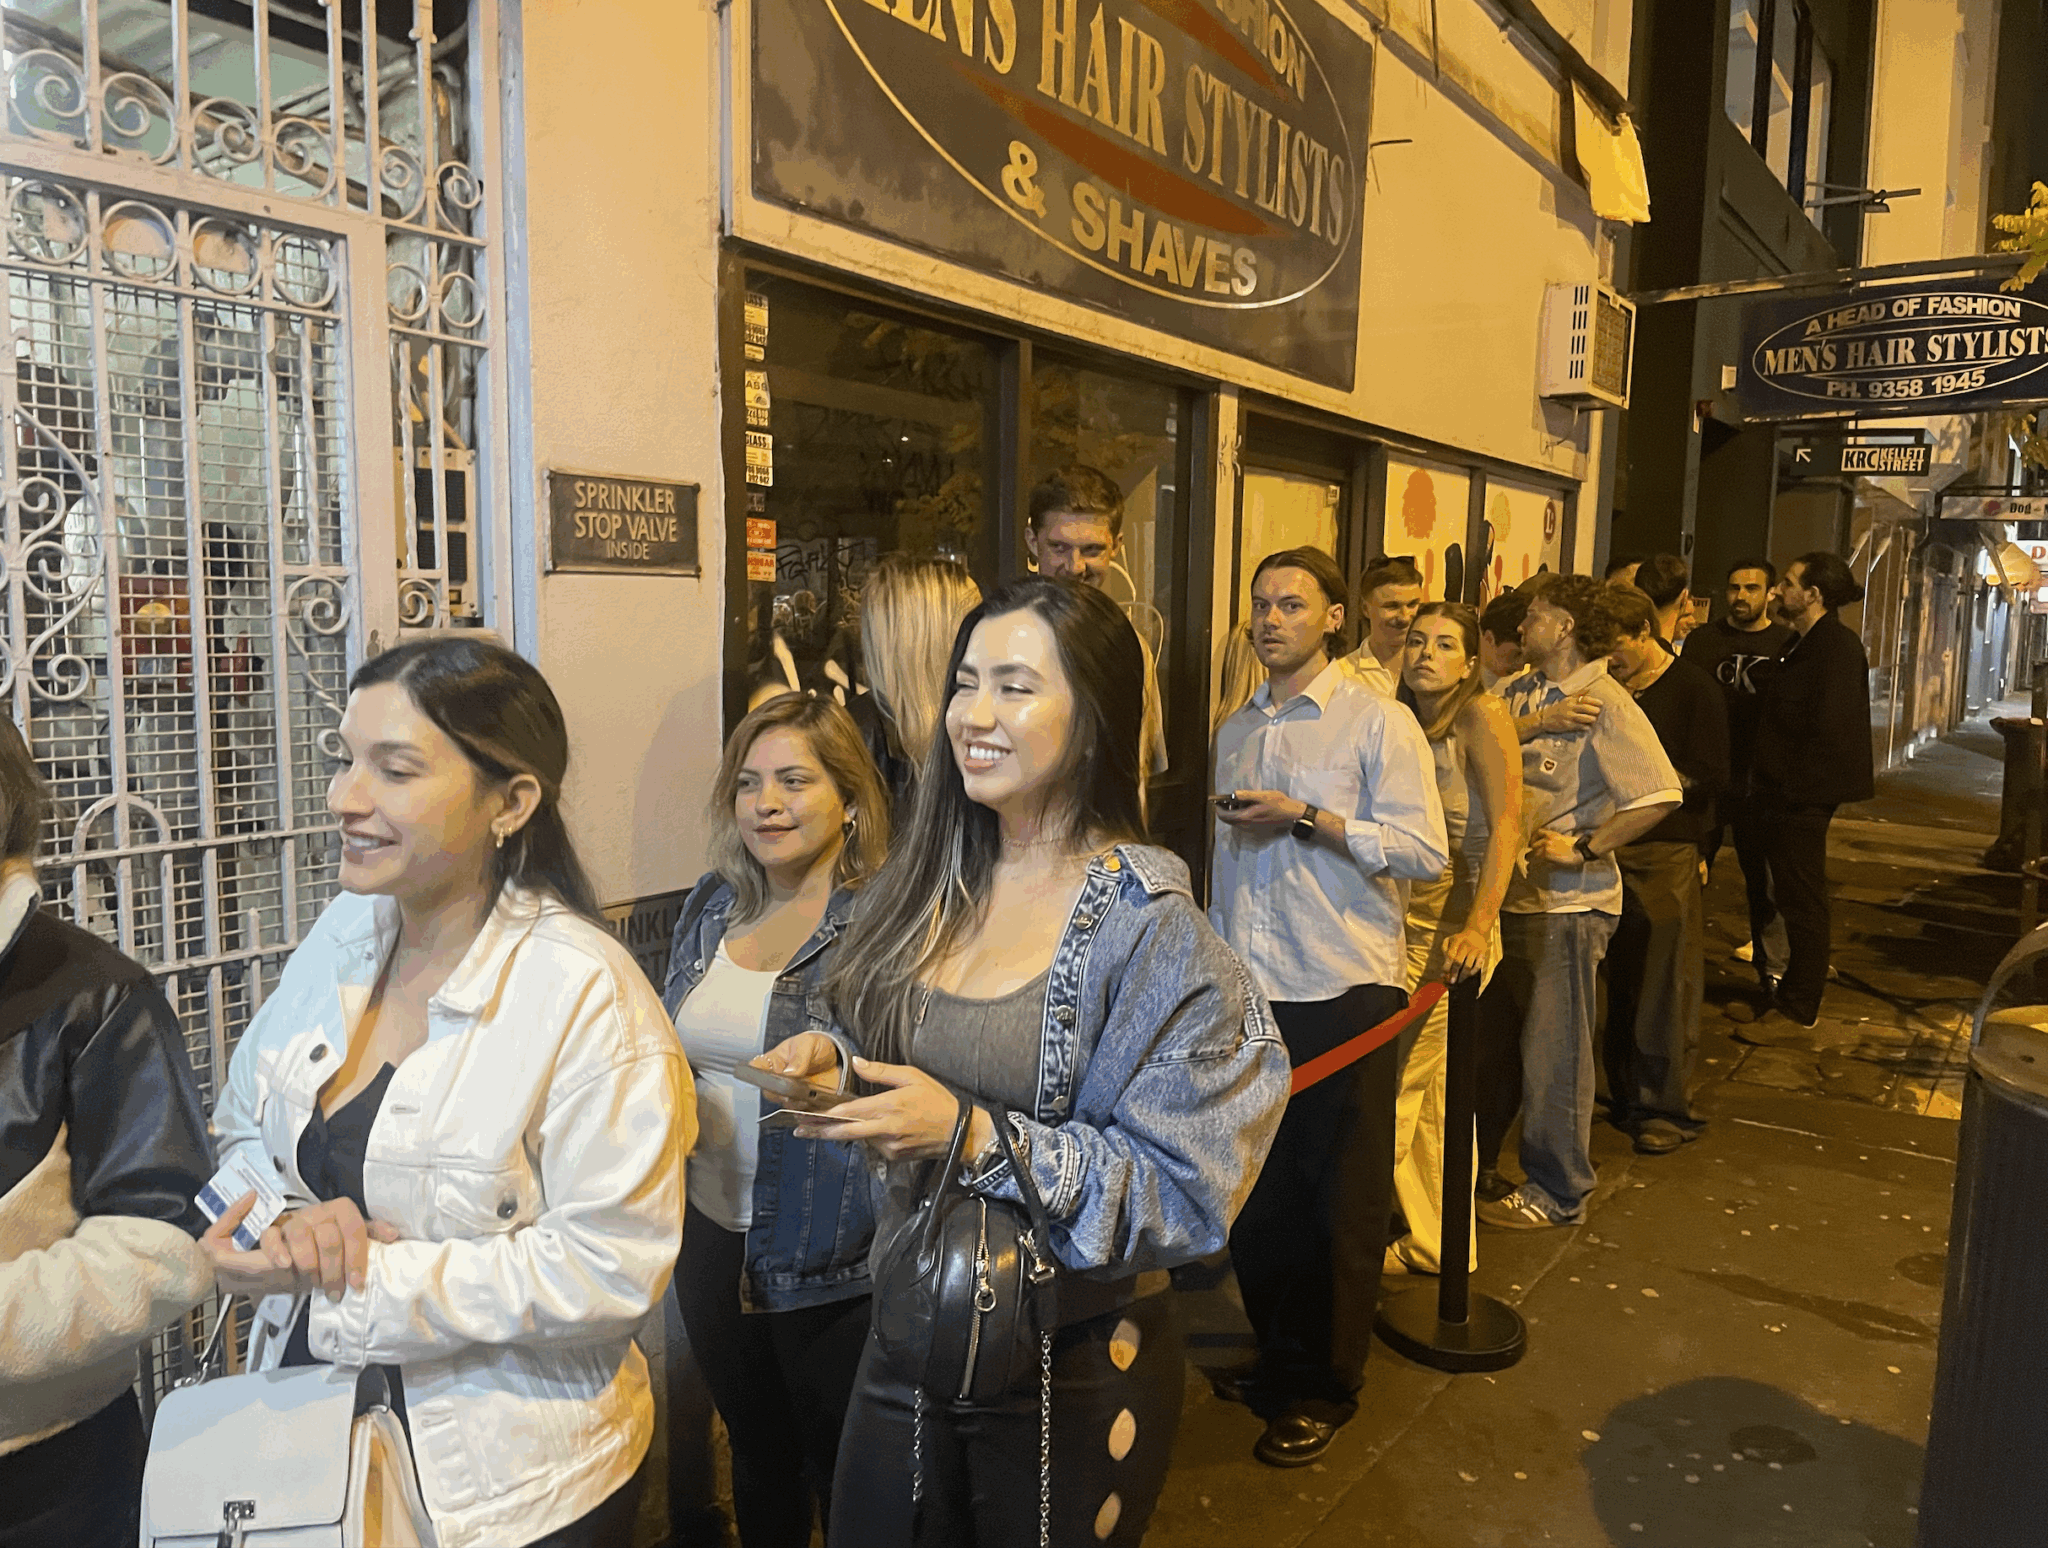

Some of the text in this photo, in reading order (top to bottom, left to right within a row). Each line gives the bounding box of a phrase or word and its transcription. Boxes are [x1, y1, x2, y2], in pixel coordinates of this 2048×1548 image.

[1037, 0, 1168, 157] HAIR
[1183, 64, 1346, 247] STYLISTS
[1001, 140, 1258, 297] & SHAVES
[1805, 296, 2022, 336] A HEAD OF FASHION
[1763, 340, 1838, 377] MEN'S
[1846, 336, 1917, 370] HAIR
[1868, 380, 1924, 399] 9358
[1931, 369, 1986, 395] 1945
[1844, 450, 1878, 469] KRC
[1879, 459, 1924, 472] STREET
[1880, 447, 1926, 460] KELLETT
[574, 480, 676, 515] SPRINKLER
[574, 511, 678, 543] STOP VALVE
[606, 540, 650, 561] INSIDE
